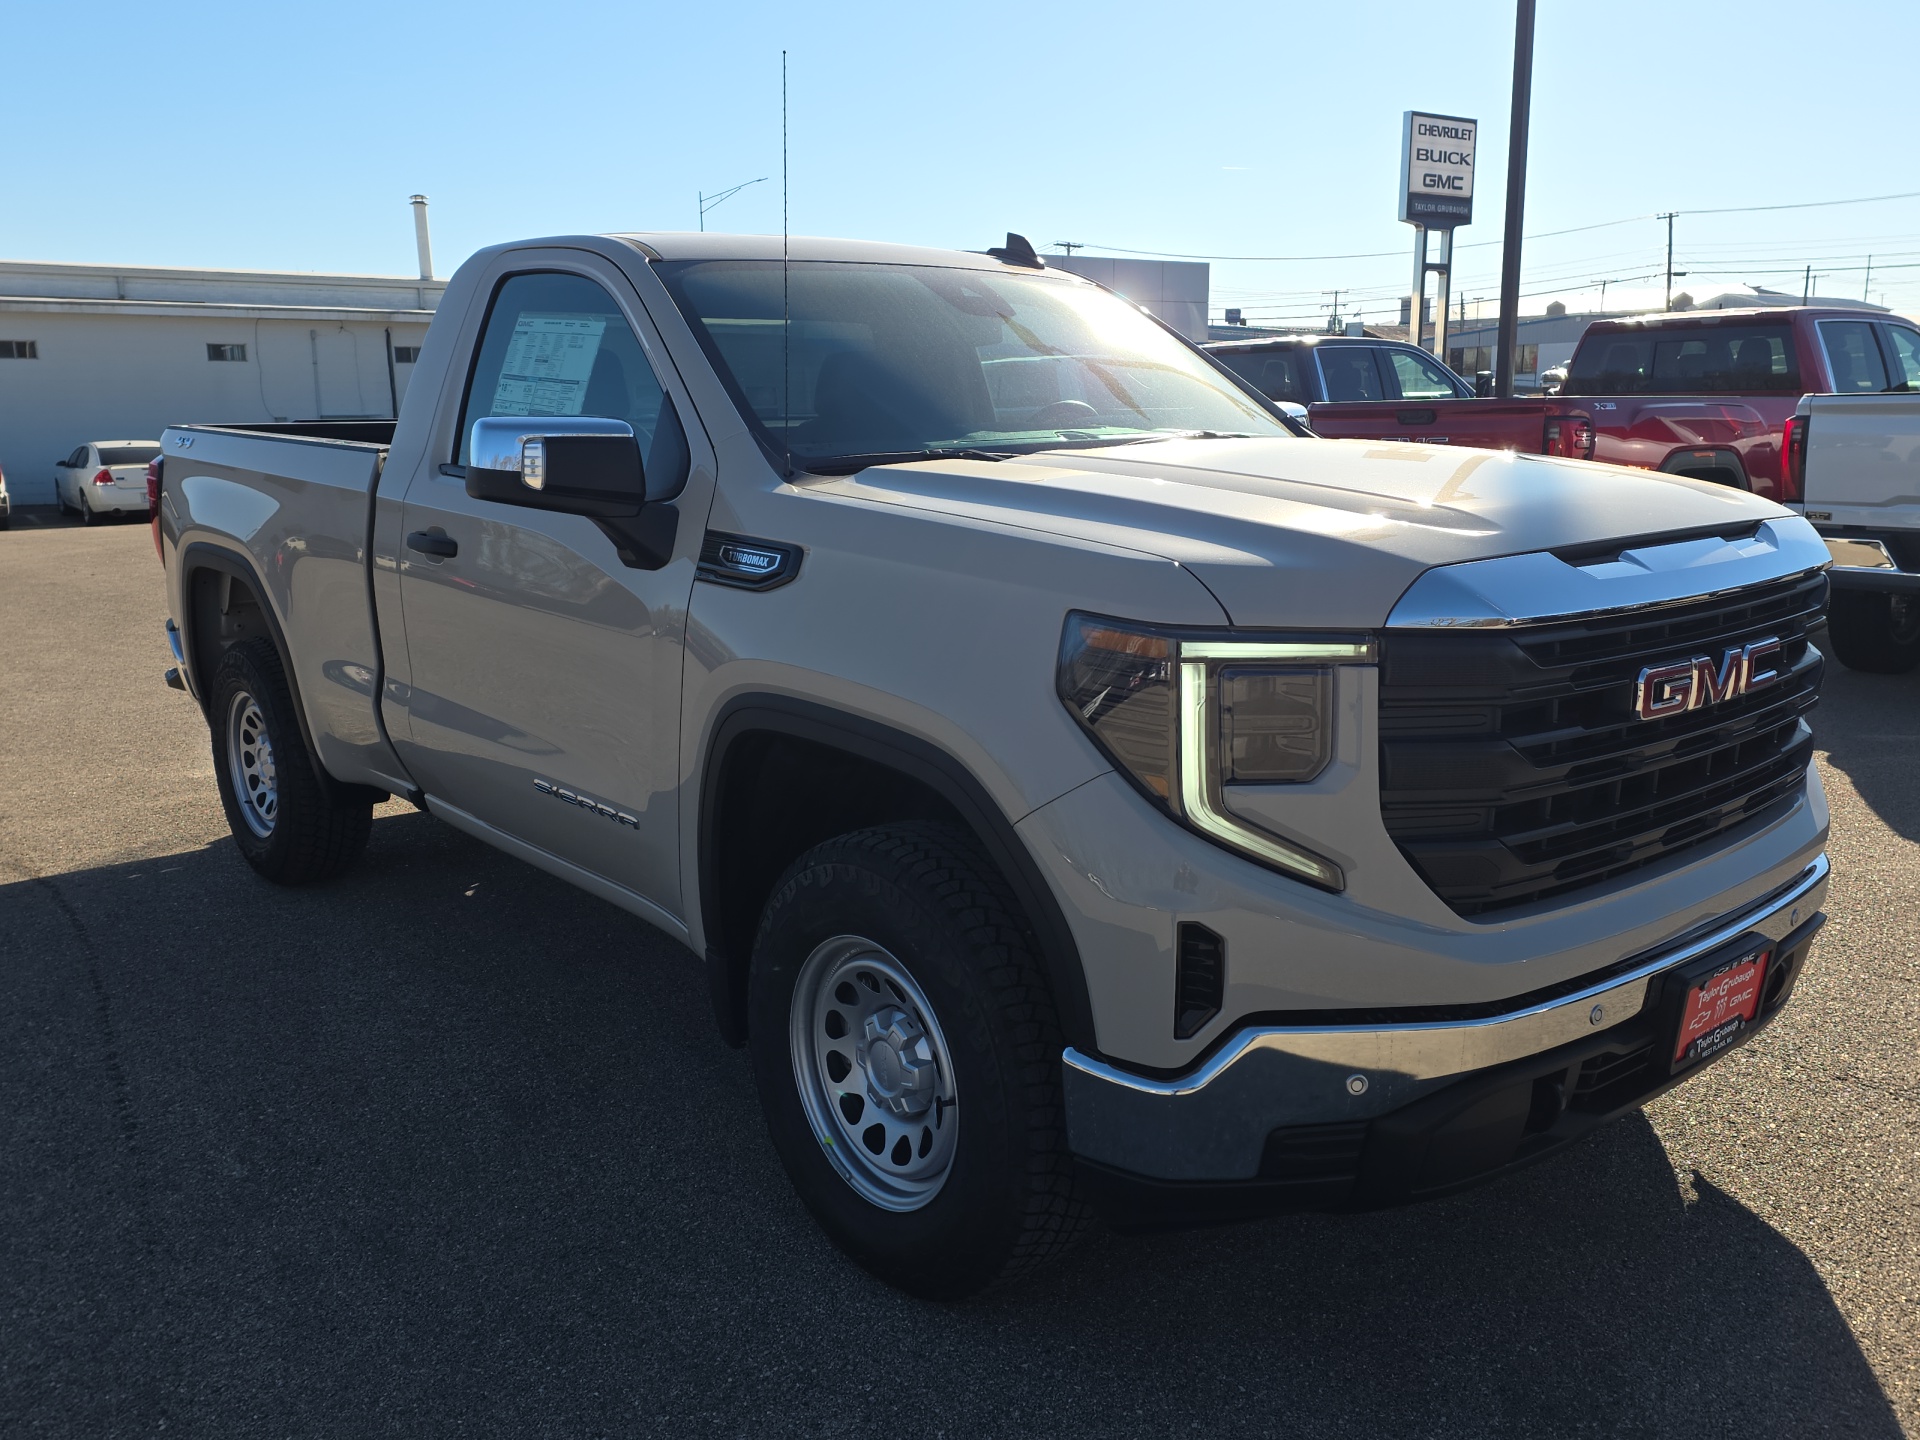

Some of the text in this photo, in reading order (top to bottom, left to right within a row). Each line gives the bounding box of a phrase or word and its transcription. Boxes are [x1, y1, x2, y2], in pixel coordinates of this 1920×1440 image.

[1418, 123, 1473, 141] CHEVROLET
[1416, 147, 1472, 167] BUICK
[1422, 172, 1464, 191] GMC
[1414, 202, 1469, 215] TAYLOR GRUBAUGH
[728, 550, 771, 568] TURBOMAX
[1634, 636, 1781, 721] GMC
[533, 778, 641, 831] SIERRA
[1741, 953, 1755, 965] GMC
[1698, 968, 1755, 1009] Taylor Grubaugh
[1730, 988, 1753, 1007] GMC
[1696, 1034, 1714, 1053] Taylor
[1713, 1020, 1739, 1043] Grubaugh
[1701, 1047, 1713, 1058] WEST
